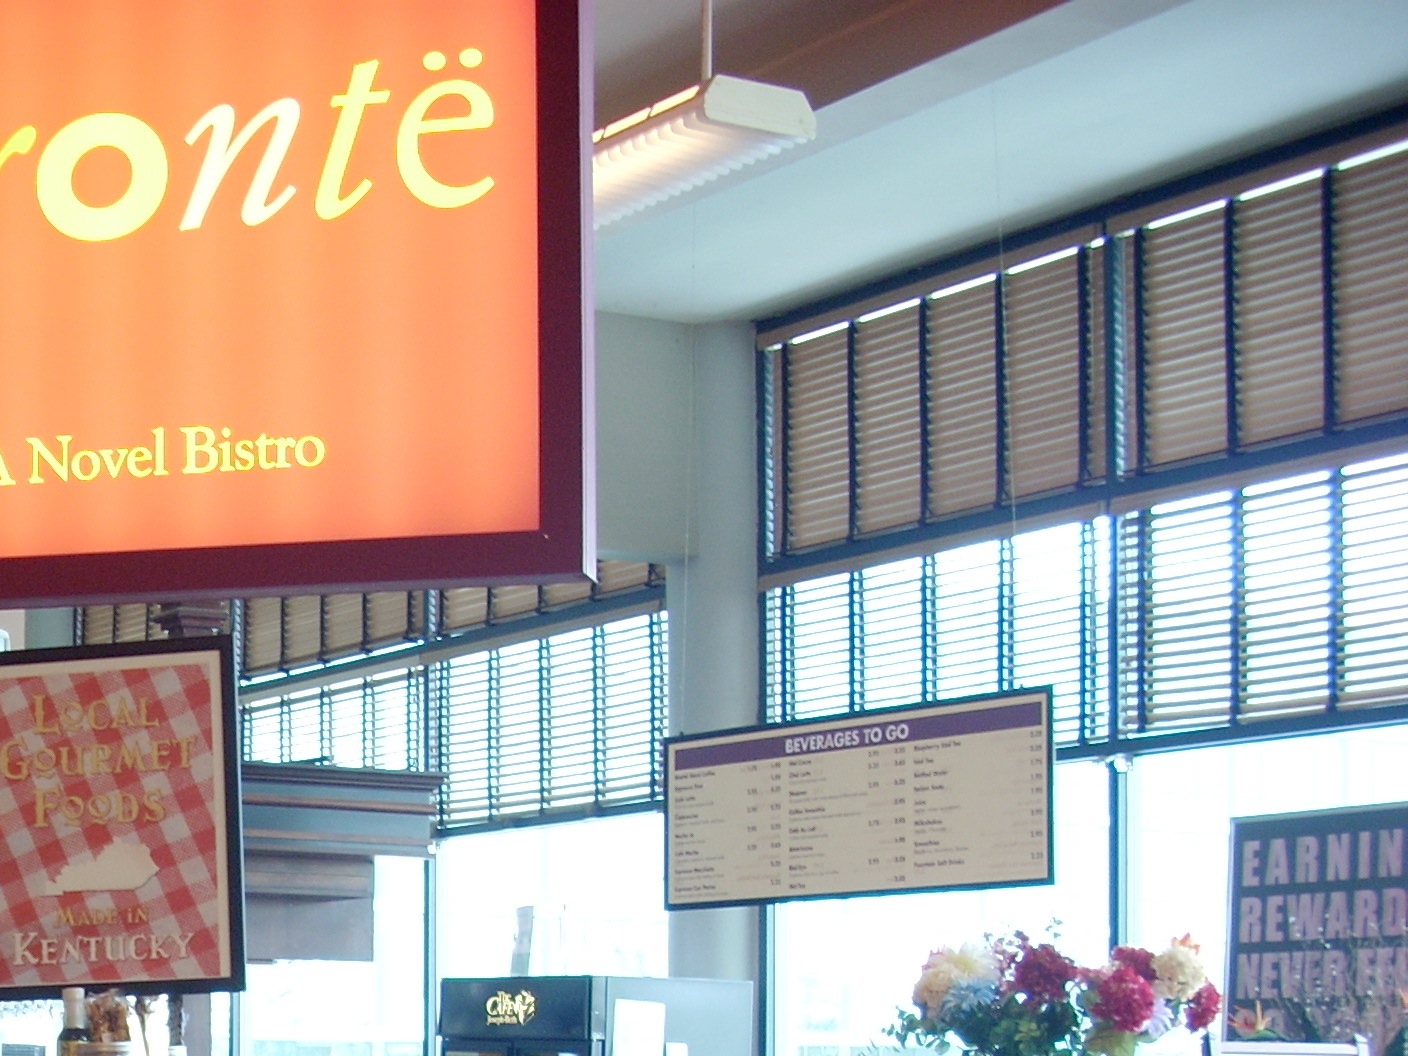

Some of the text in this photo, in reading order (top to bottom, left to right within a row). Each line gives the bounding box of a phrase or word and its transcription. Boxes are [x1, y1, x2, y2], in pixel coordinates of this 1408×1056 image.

[27, 428, 170, 486] Novel
[181, 425, 327, 475] Bistro
[33, 694, 159, 735] LOCAL
[785, 724, 909, 754] BEVERAGES TO GO
[33, 787, 167, 828] FOODS
[13, 931, 195, 966] KENTUCKY
[1235, 951, 1349, 1000] NEVER
